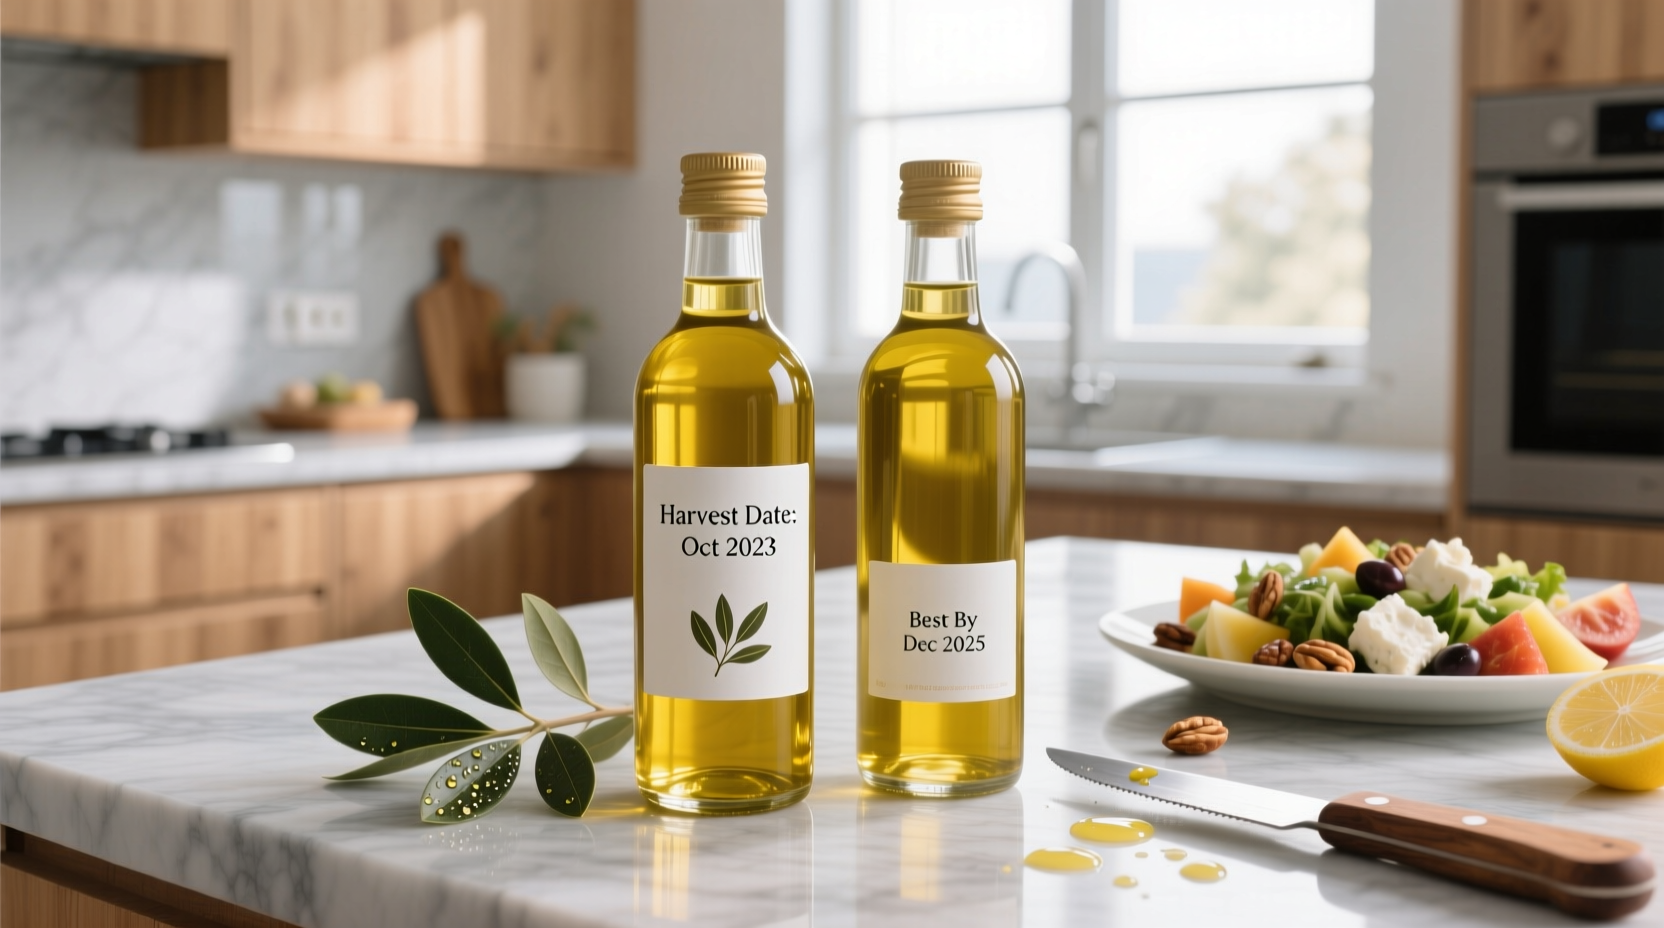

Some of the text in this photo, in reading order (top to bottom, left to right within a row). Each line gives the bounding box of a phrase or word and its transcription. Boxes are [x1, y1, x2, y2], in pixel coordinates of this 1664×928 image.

[659, 503, 798, 526] Harvest Date:
[681, 535, 776, 558] Oct 2023
[909, 610, 979, 633] Best By
[903, 634, 986, 653] Dec 2025
